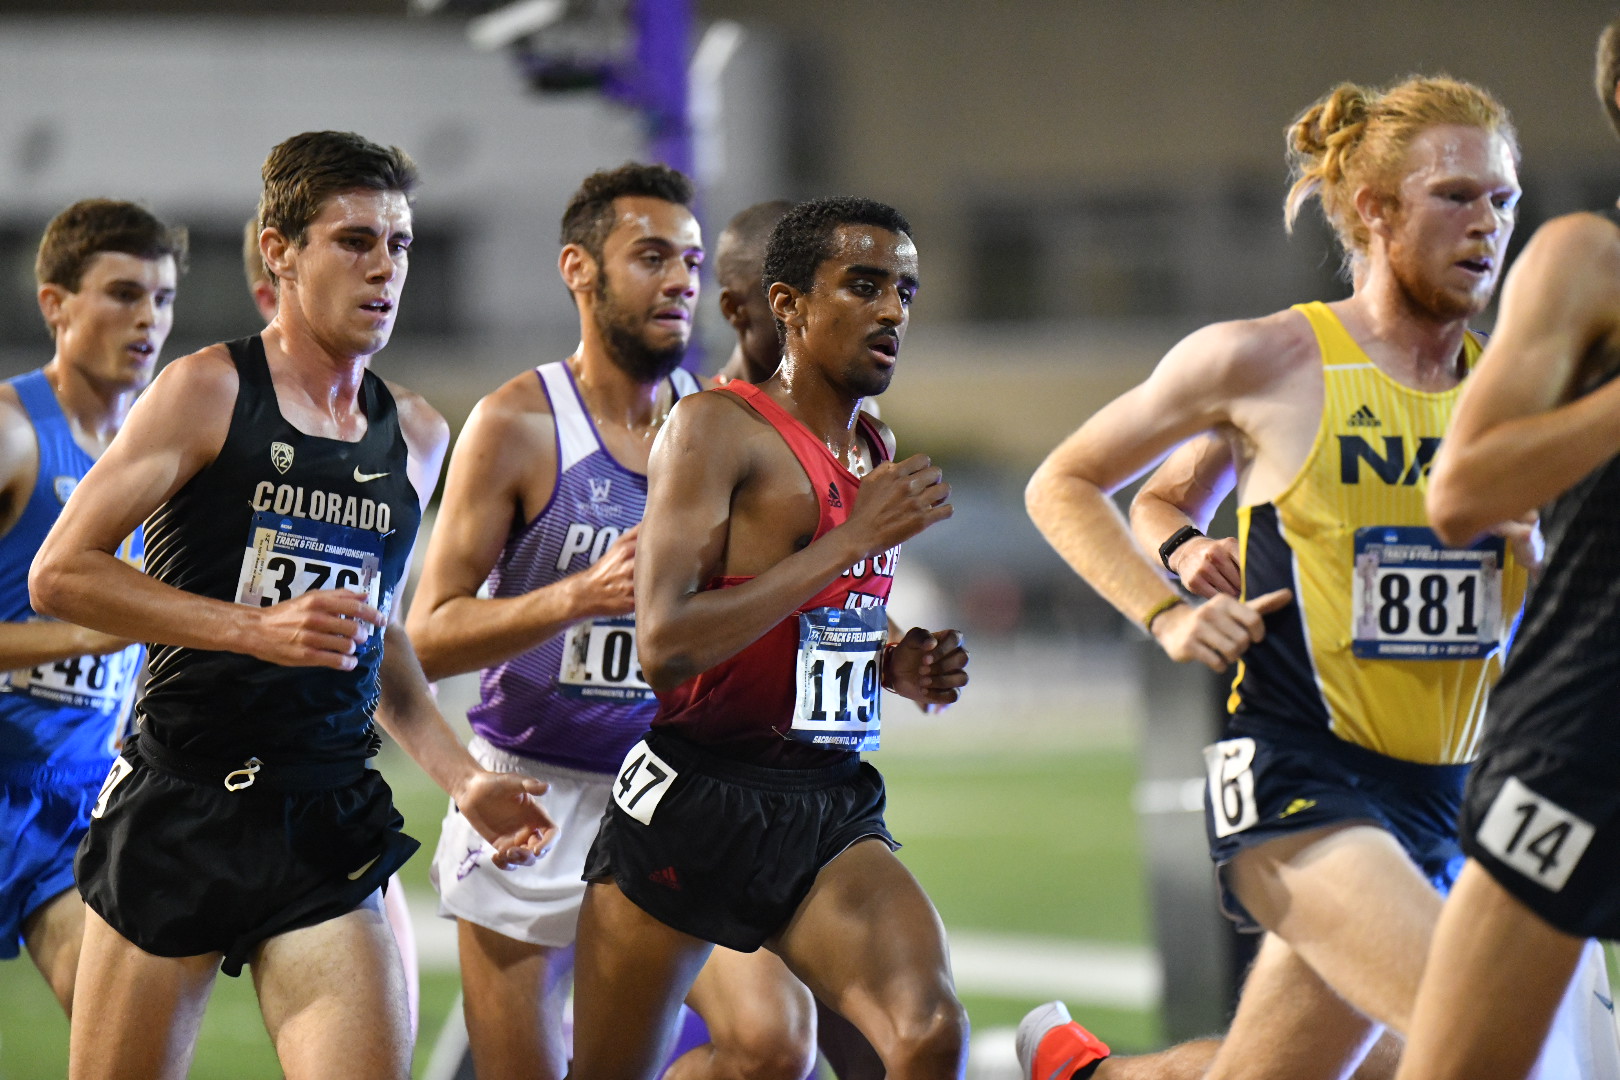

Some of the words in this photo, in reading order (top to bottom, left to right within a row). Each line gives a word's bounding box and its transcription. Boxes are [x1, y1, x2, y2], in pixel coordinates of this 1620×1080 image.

[276, 456, 288, 468] 12
[253, 481, 391, 534] COLORADO
[275, 535, 301, 548] TRACK
[305, 541, 325, 552] FIELD
[556, 523, 634, 571] PO
[1379, 573, 1478, 636] 881
[572, 630, 647, 683] 10
[822, 631, 847, 642] TRACK
[851, 632, 866, 643] FIELD
[808, 659, 880, 722] 119
[812, 735, 850, 746] SACRAMENTO,
[850, 736, 858, 745] CA
[618, 752, 668, 811] 47
[1504, 803, 1574, 875] 14
